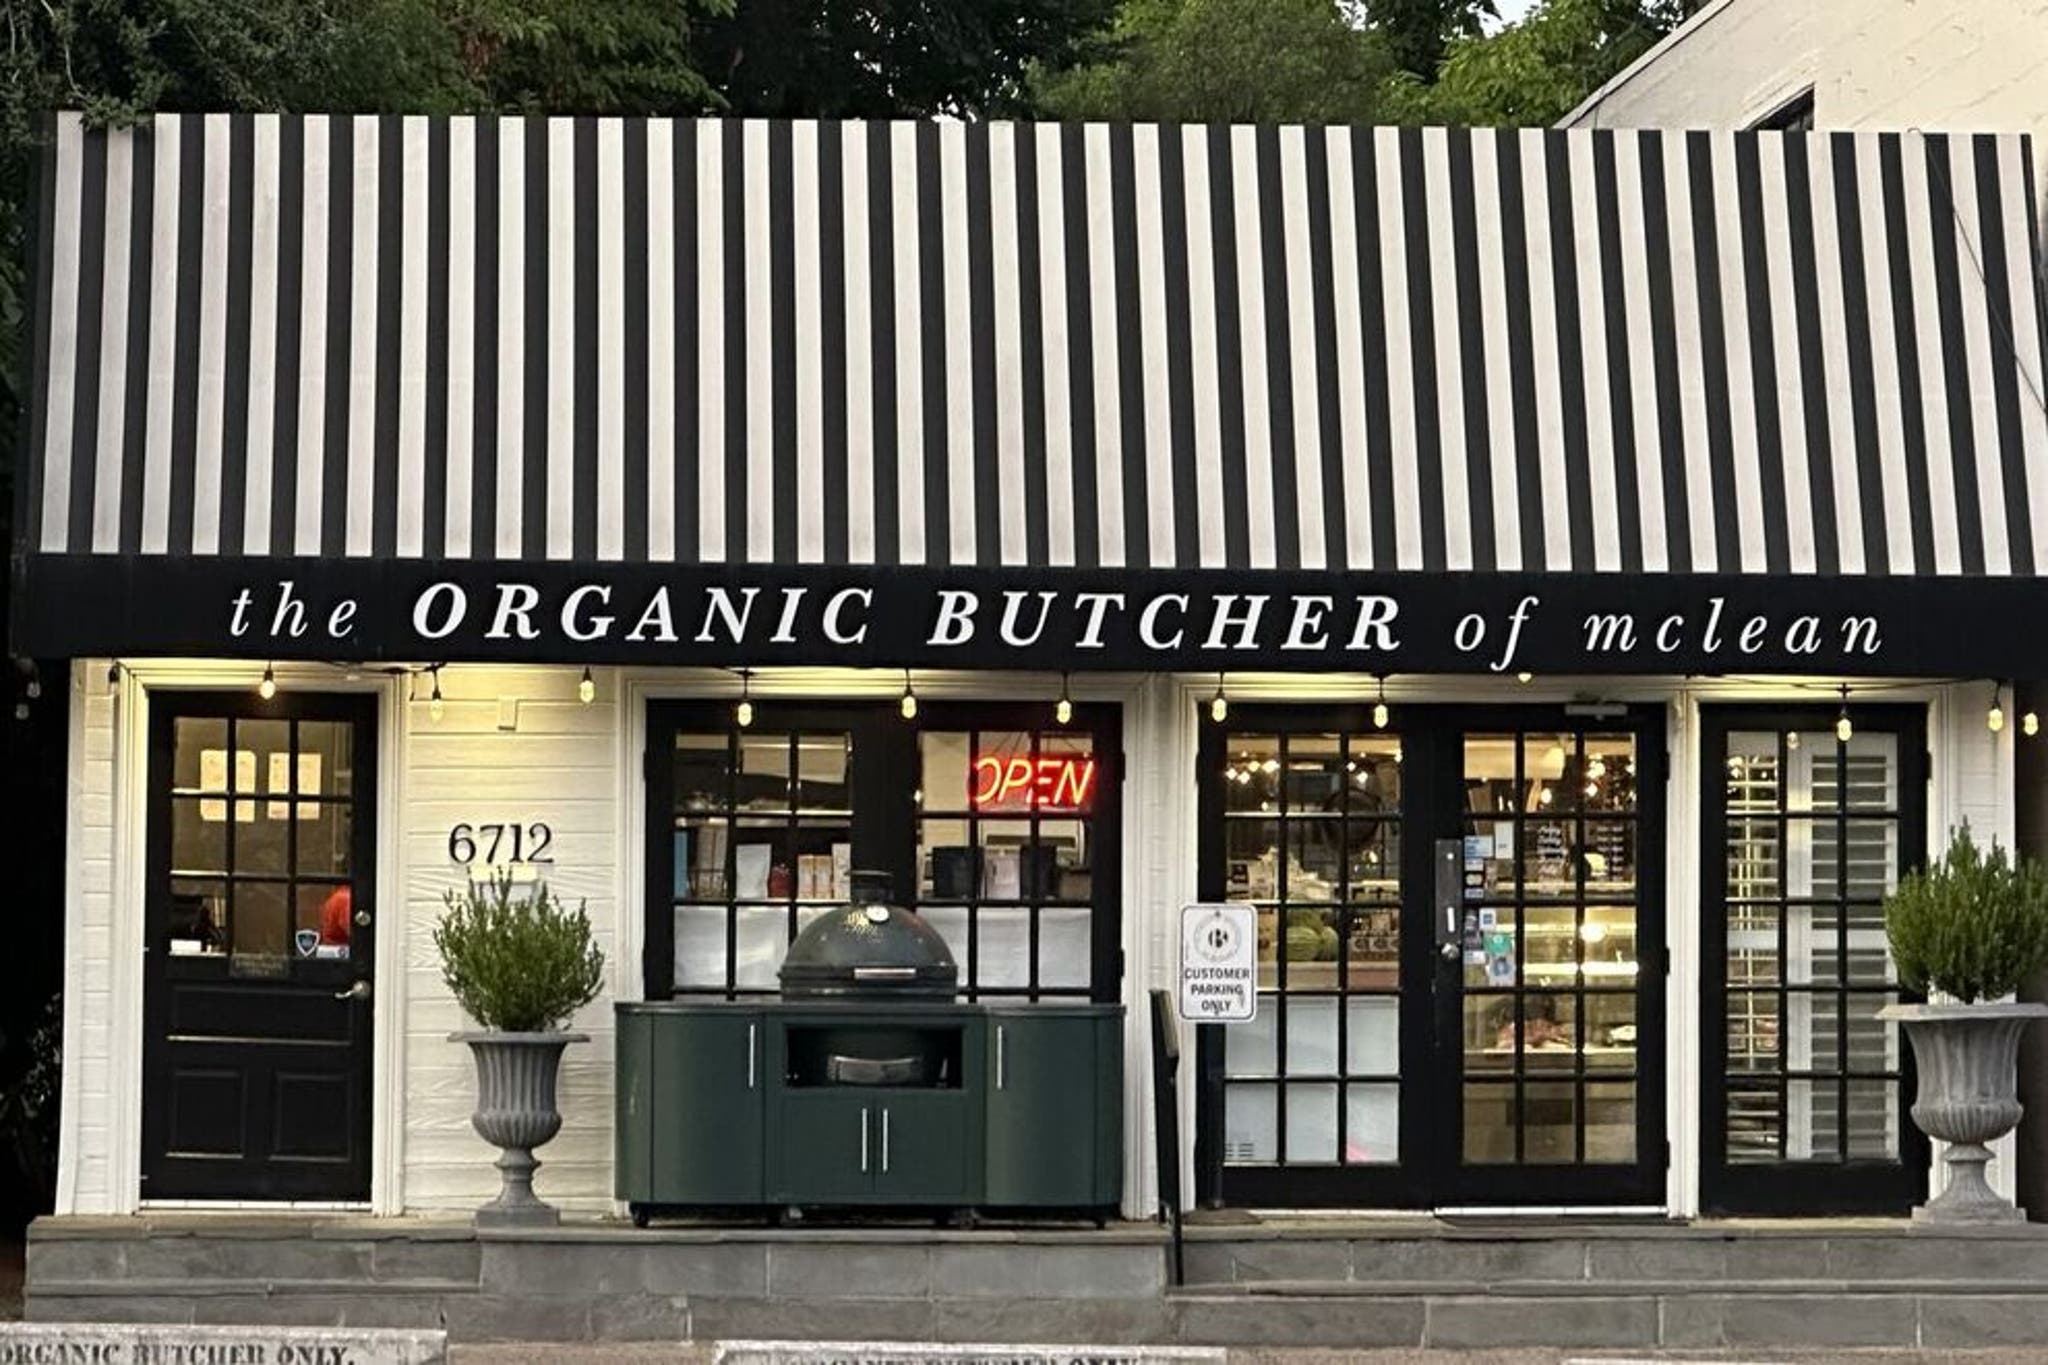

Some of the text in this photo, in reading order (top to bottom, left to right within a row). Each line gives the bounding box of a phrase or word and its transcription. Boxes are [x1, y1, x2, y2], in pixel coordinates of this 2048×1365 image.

[230, 581, 1882, 671] the ORGANIC BUTCHER of mclean
[976, 757, 1094, 804] OPEN
[449, 823, 554, 865] 6712
[1184, 967, 1250, 979] CUSTOMER
[1191, 984, 1244, 995] PARKING
[1201, 1000, 1231, 1012] ONLY
[132, 1343, 266, 1365] BUTCHER
